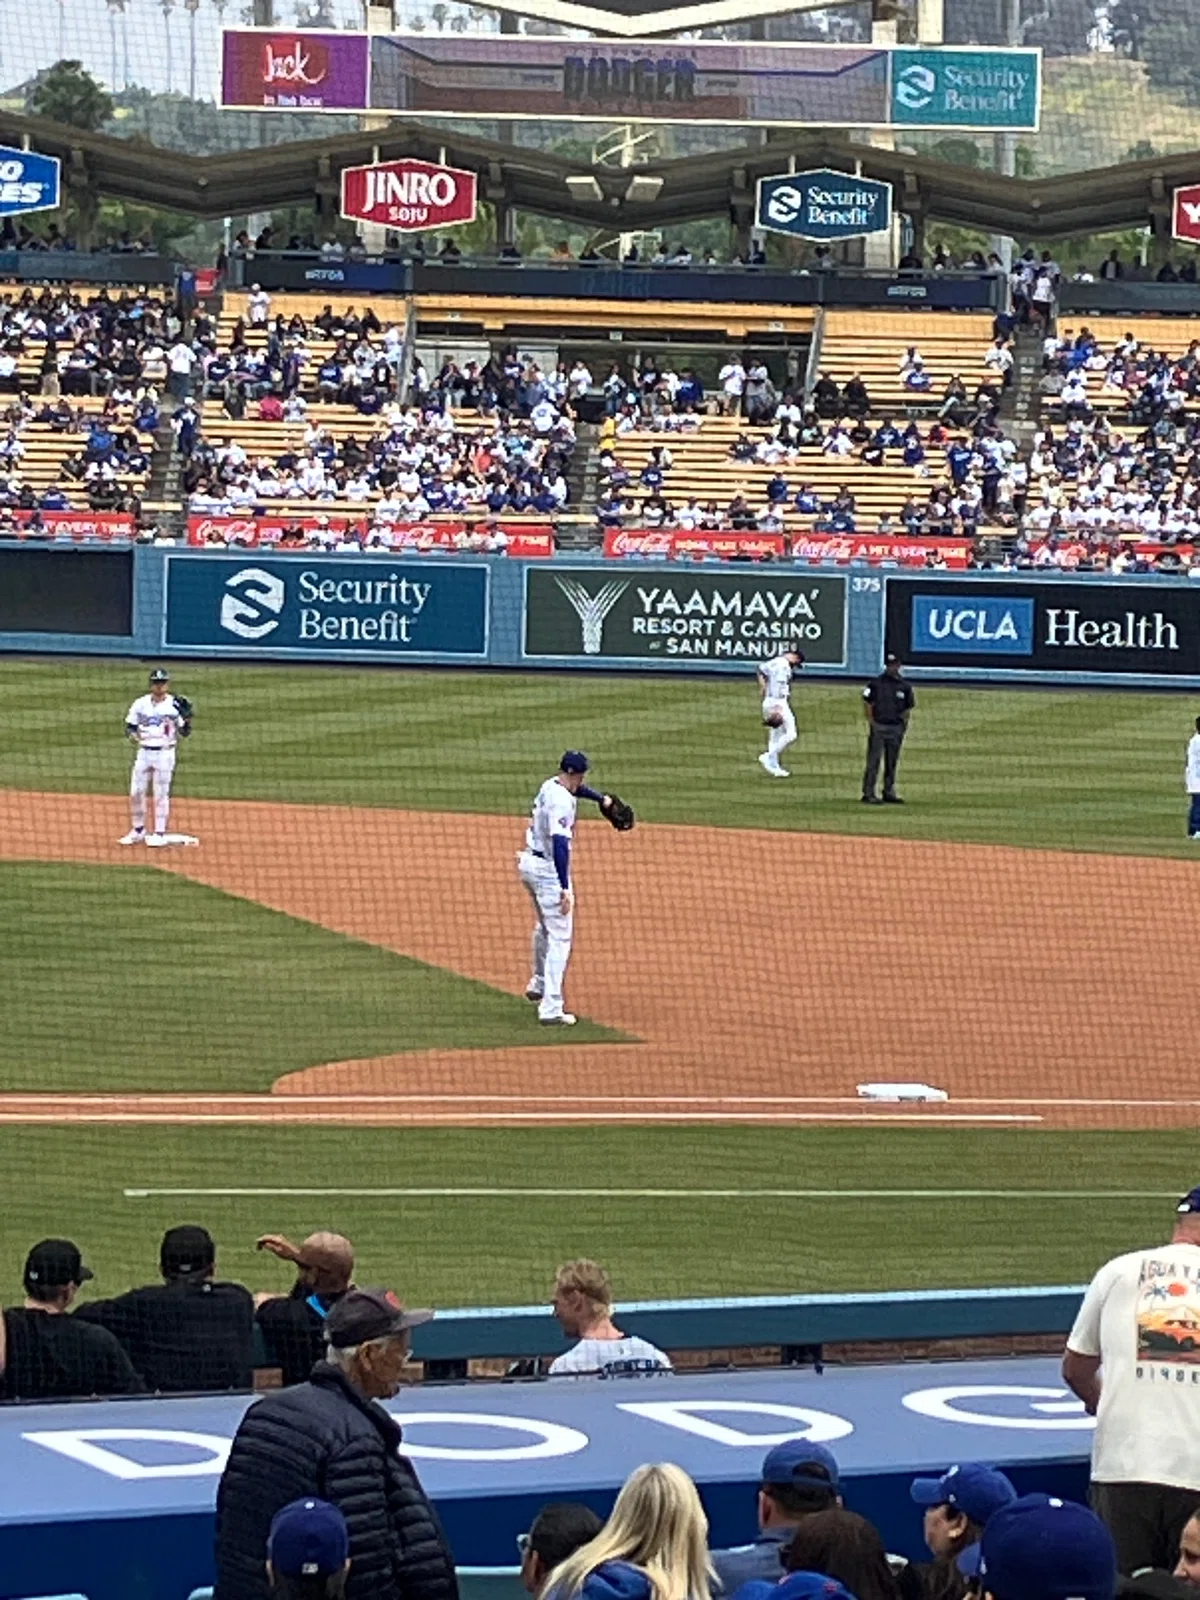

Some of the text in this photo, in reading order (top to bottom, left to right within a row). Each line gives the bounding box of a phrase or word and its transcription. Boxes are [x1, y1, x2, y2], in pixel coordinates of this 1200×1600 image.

[262, 41, 327, 84] Jack
[943, 65, 1030, 99] Security
[944, 88, 1018, 111] Benefit
[361, 171, 456, 213] JINRO
[807, 186, 878, 211] Security
[388, 206, 428, 222] SOJU
[807, 205, 869, 225] Benefit
[611, 532, 674, 554] Coca-Cola
[792, 537, 854, 558] Coca-Cola
[299, 571, 431, 613] Security
[852, 577, 881, 592] 375
[637, 587, 820, 620] YAAMAVA'
[299, 608, 413, 642] Benefit
[632, 617, 822, 639] RESORT & CASINO
[928, 608, 1179, 649] UCLA Health
[666, 636, 708, 655] SAN
